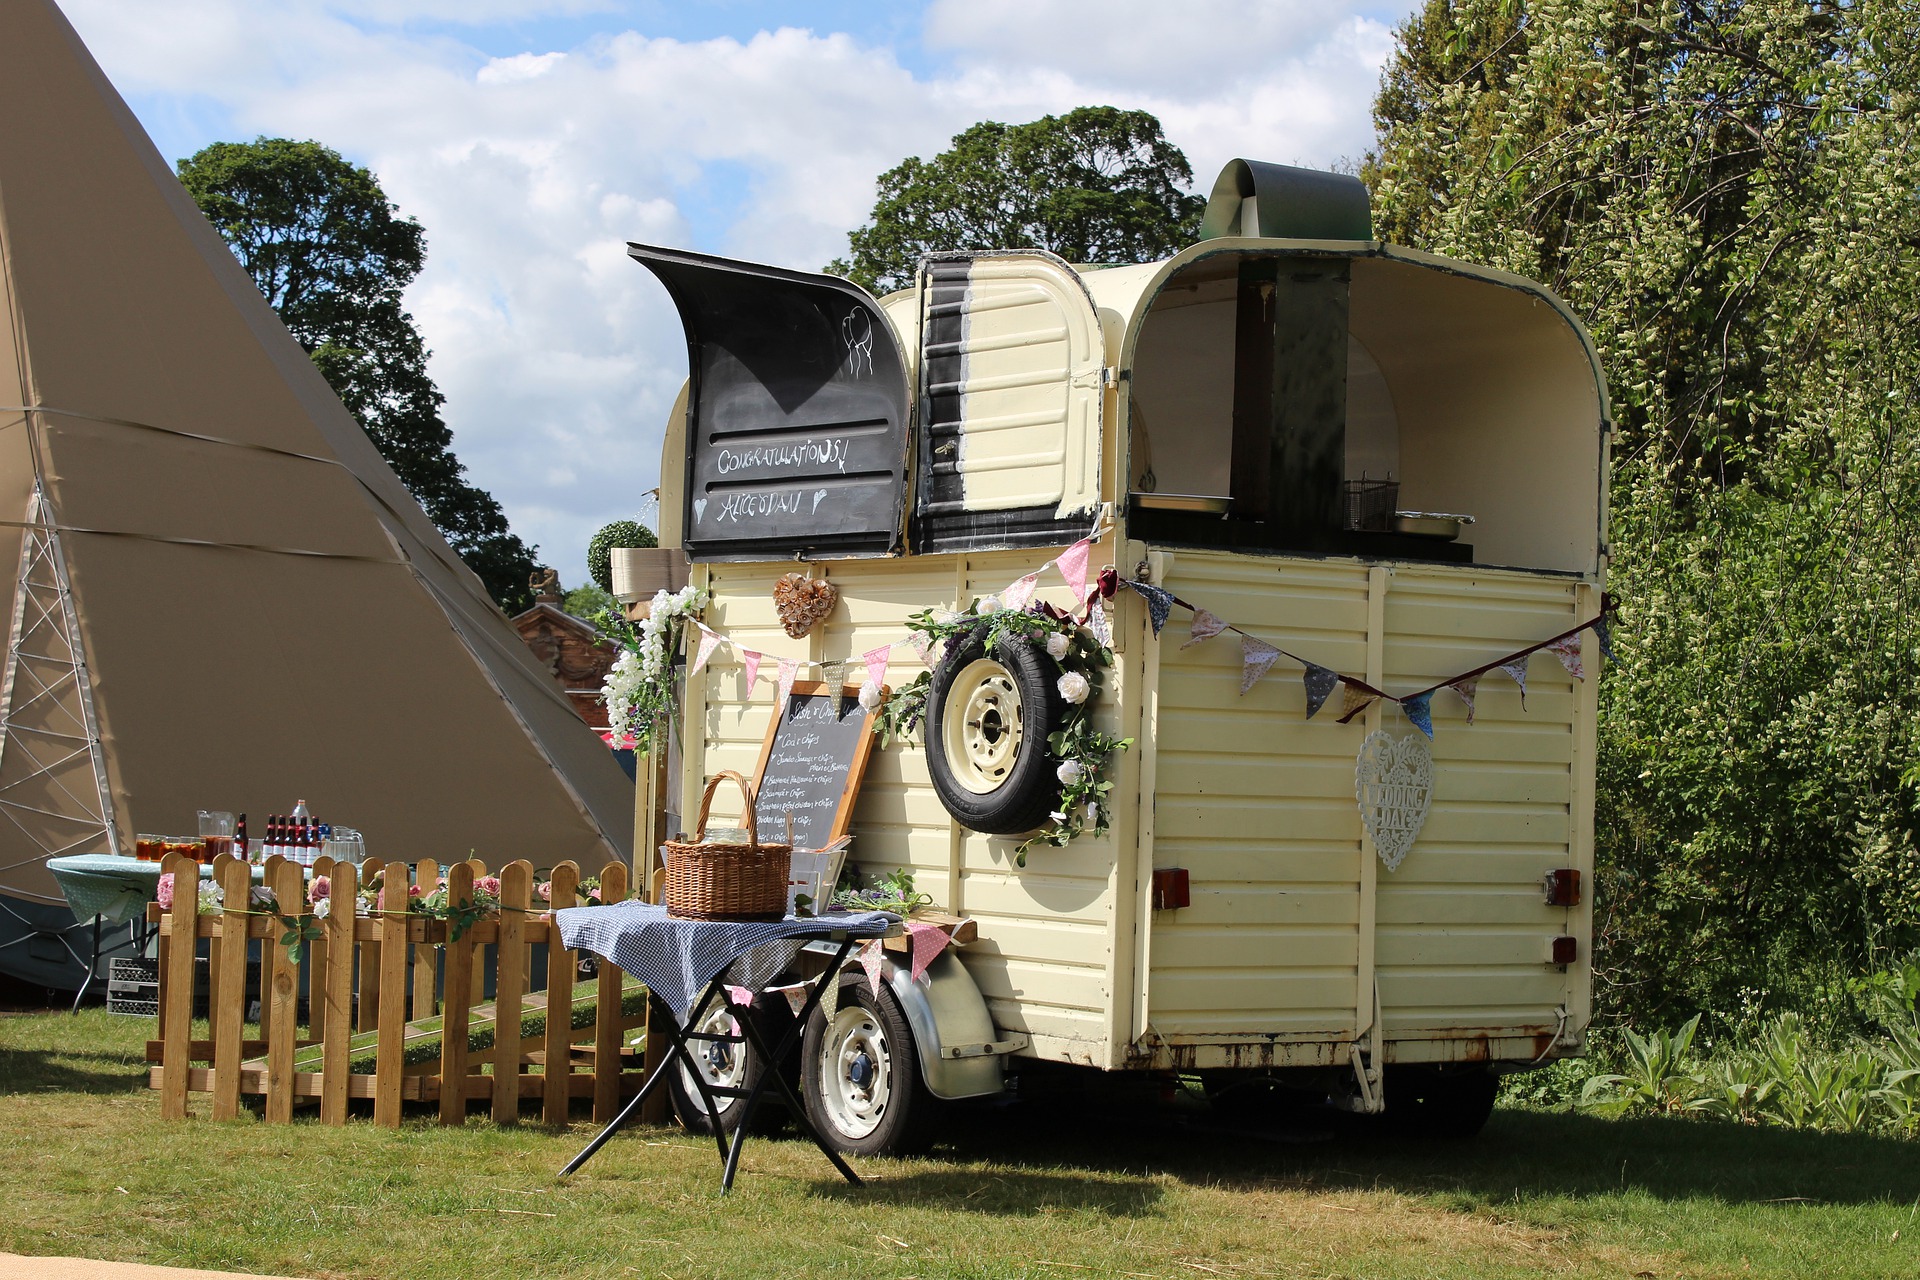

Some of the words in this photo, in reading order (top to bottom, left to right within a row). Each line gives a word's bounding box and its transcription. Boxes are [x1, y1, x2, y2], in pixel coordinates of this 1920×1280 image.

[766, 491, 802, 516] DAN
[1366, 785, 1423, 808] WEDDING
[1382, 807, 1408, 828] DAY
